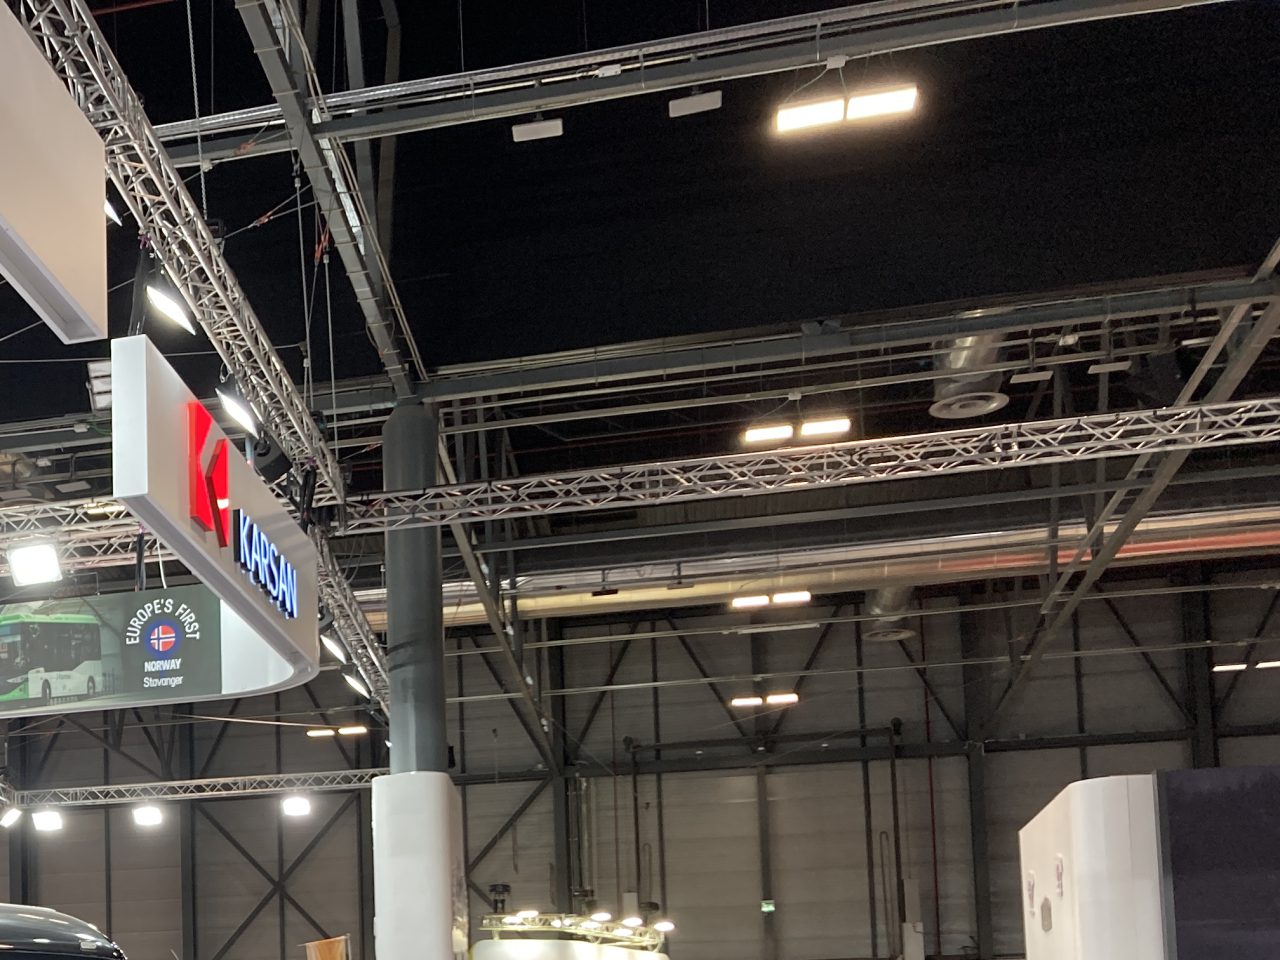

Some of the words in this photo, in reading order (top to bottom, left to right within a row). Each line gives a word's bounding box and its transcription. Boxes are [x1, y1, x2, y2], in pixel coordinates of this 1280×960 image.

[235, 508, 299, 619] KARSAN
[125, 598, 174, 645] EUROPE'S
[174, 603, 200, 640] FIRST
[144, 658, 182, 672] NORWAY
